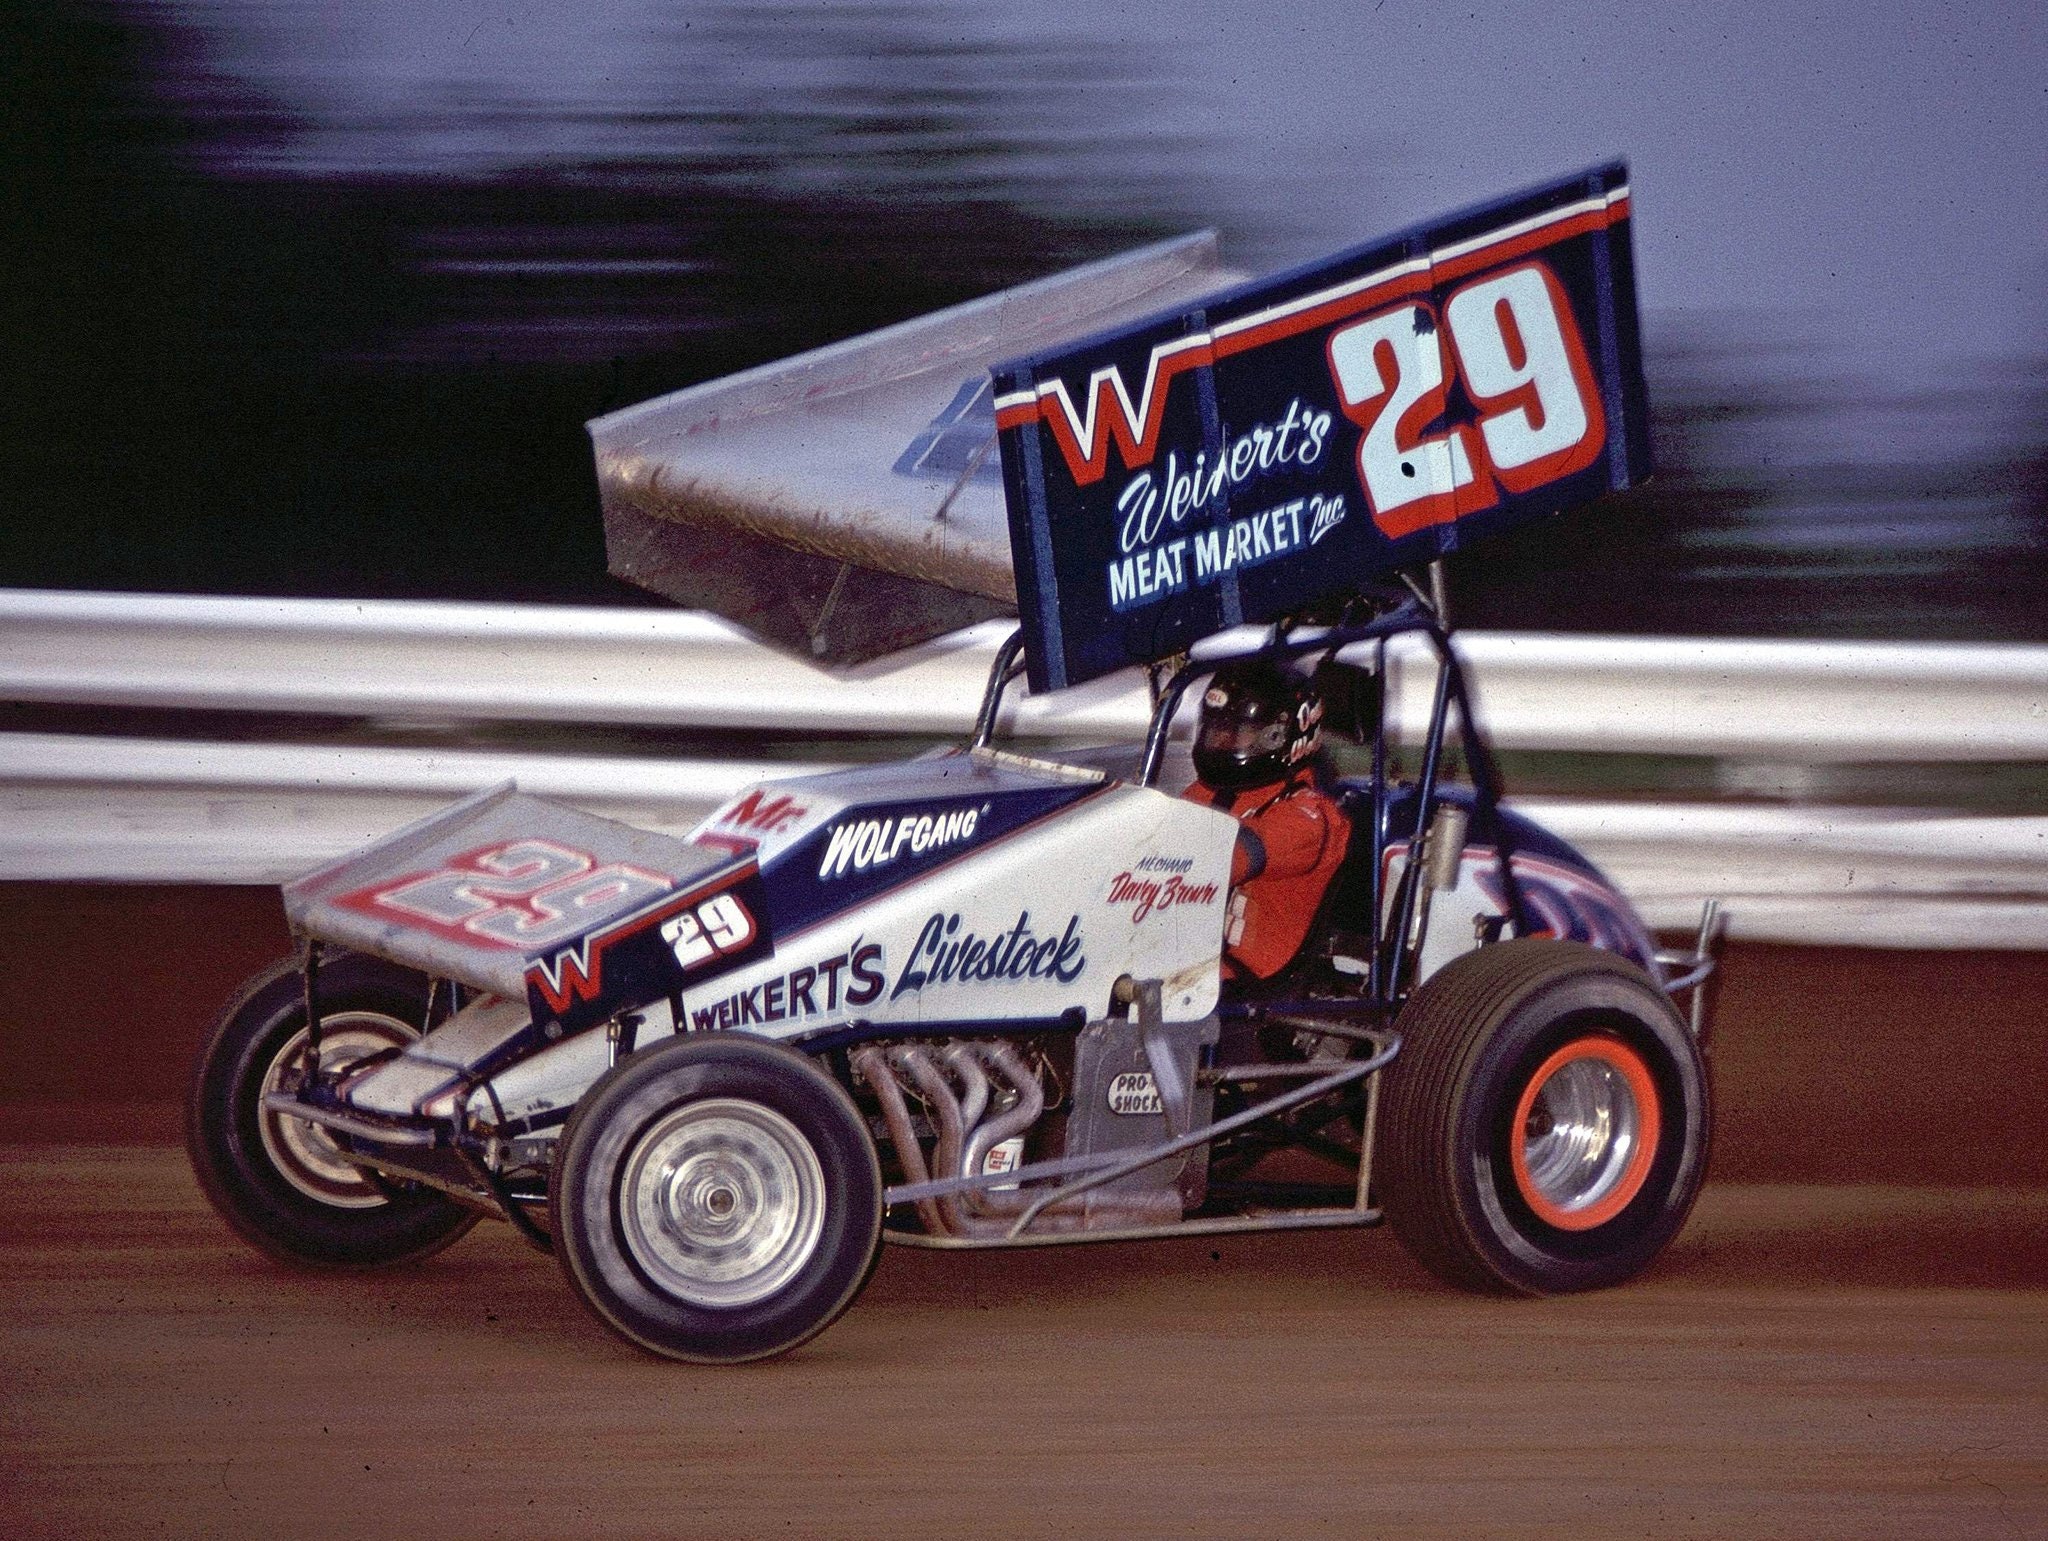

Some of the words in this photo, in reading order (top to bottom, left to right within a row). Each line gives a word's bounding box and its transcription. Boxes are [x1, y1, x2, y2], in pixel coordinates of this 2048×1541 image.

[1040, 346, 1175, 487] W
[1329, 265, 1592, 518] 29
[1109, 540, 1186, 606] MEAT
[1194, 501, 1304, 578] MARKET
[1309, 496, 1345, 545] Inc.
[1135, 856, 1194, 873] MECHANIC
[1156, 875, 1219, 910] Brown
[524, 936, 601, 1014] W
[660, 893, 752, 972] 29
[691, 933, 885, 1031] WEIKERT'S
[890, 911, 1085, 1001] Livestock
